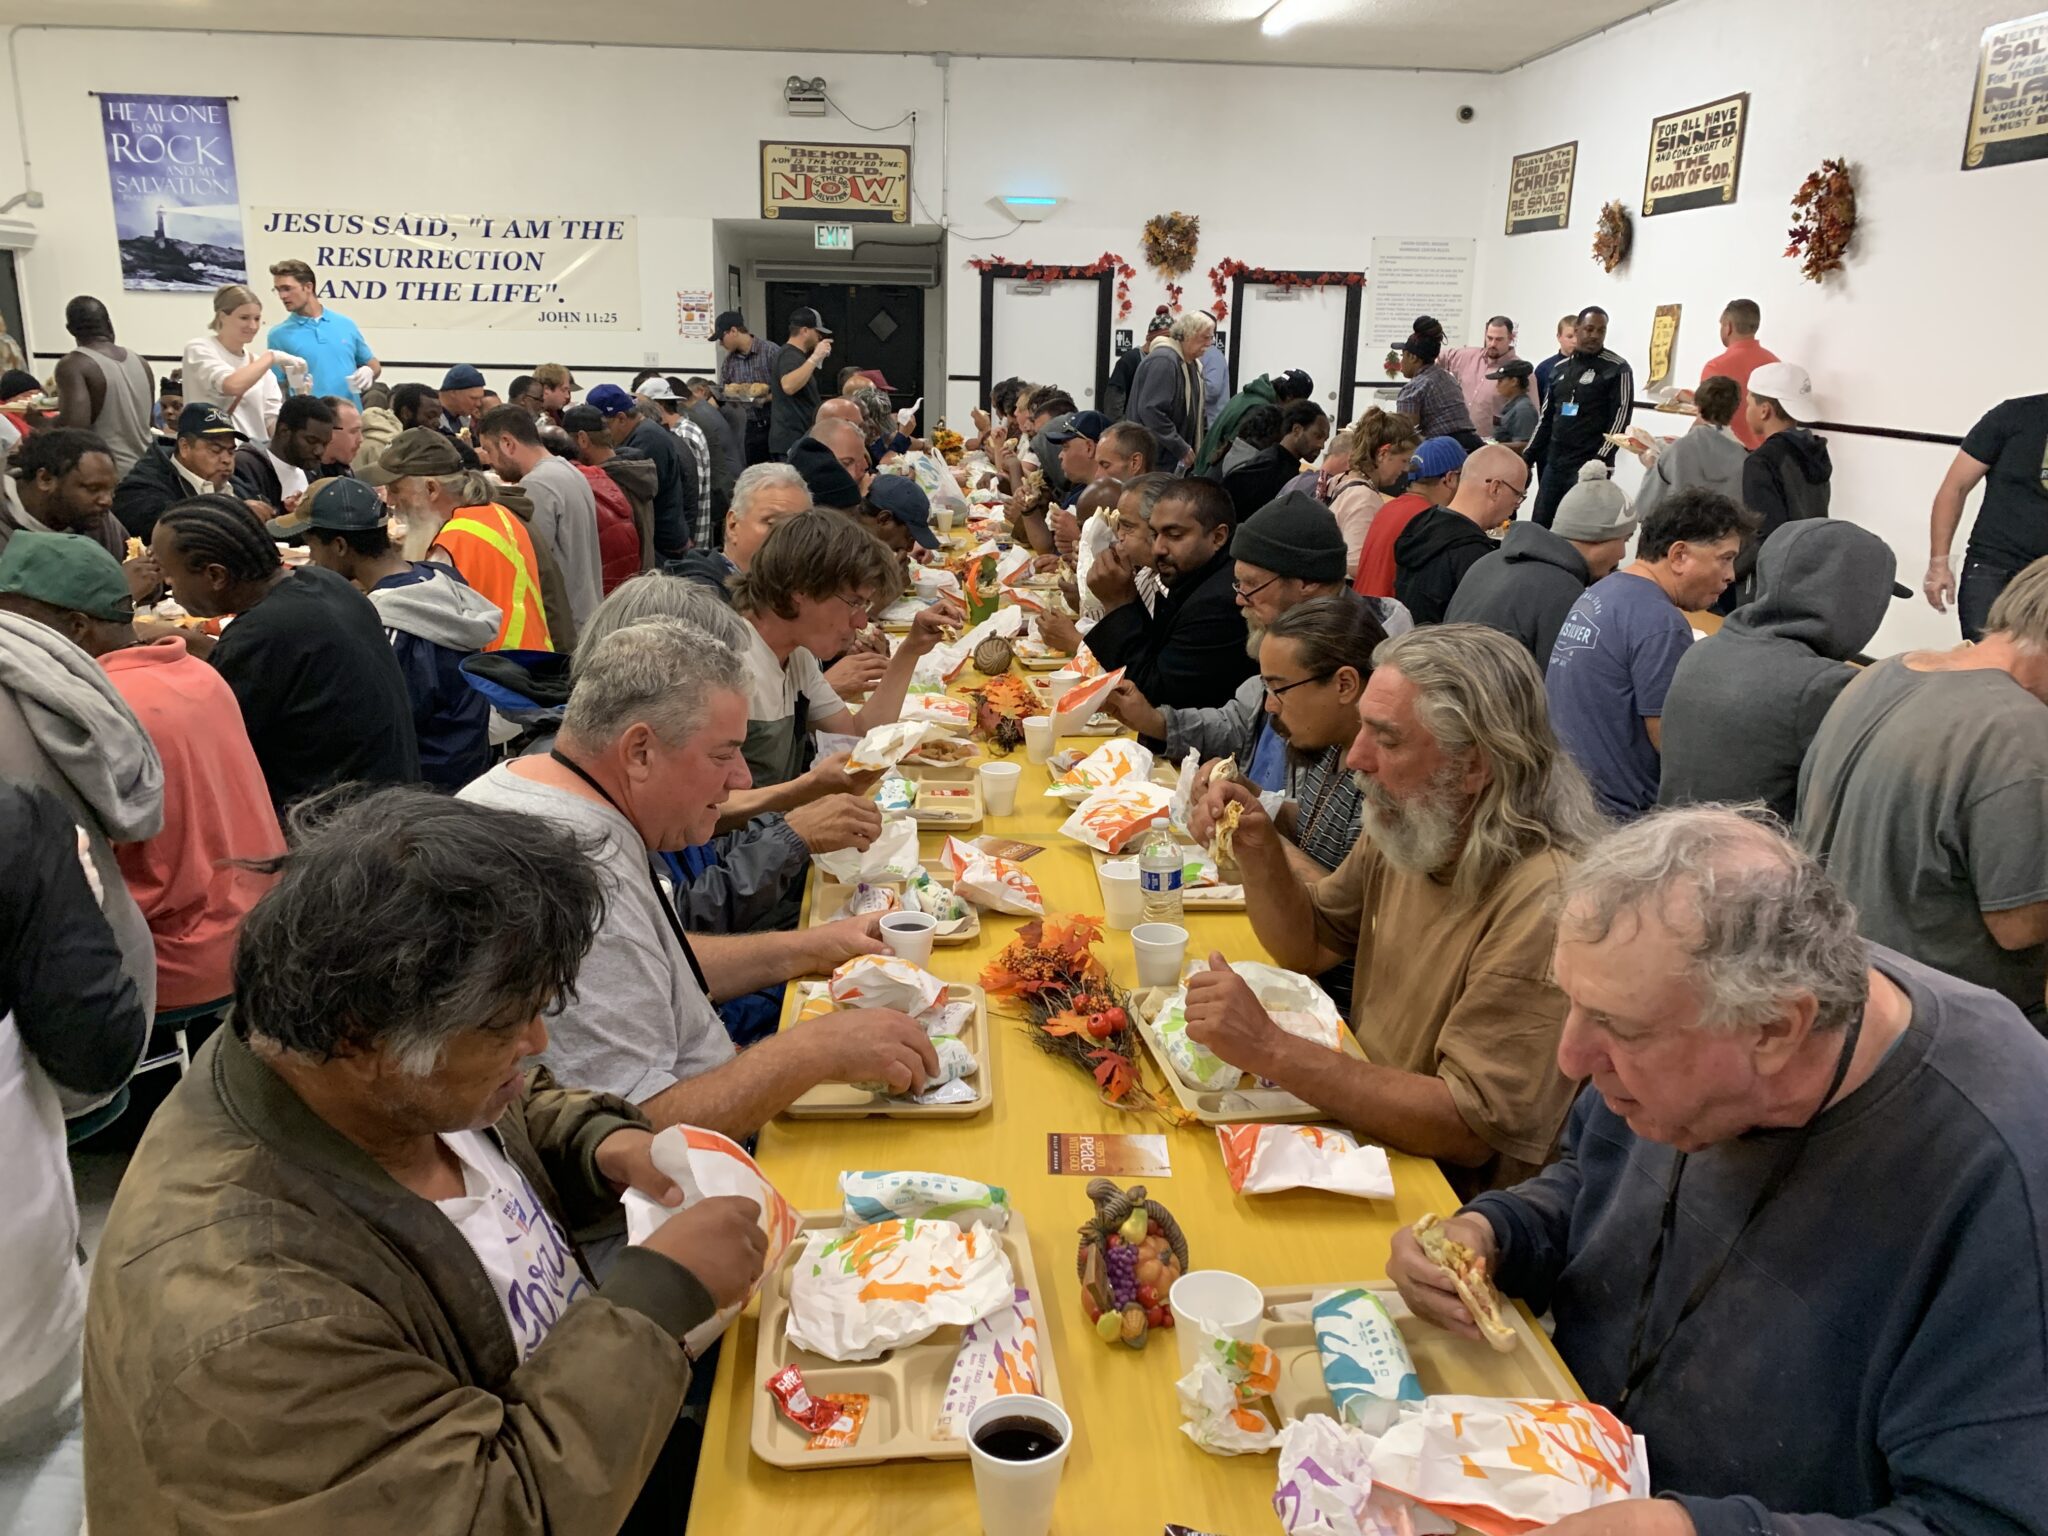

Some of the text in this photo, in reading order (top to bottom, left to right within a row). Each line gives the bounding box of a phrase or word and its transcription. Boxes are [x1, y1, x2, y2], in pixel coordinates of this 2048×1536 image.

[1992, 25, 2048, 46] NEITH
[1983, 74, 2048, 105] NA
[1987, 73, 2007, 86] FOR
[108, 102, 222, 124] HE ALONE
[1983, 97, 2027, 115] UNDER
[1990, 107, 2034, 123] AMONG
[131, 122, 164, 134] IS MY
[1659, 106, 1738, 138] FOR ALL HAVE
[1979, 114, 2048, 136] WE MUST B
[111, 133, 225, 165] ROCK
[1516, 157, 1544, 169] BELIEVE
[1556, 149, 1571, 159] THE
[1656, 136, 1734, 163] AND COME SHORT OF
[167, 165, 216, 177] AND MY
[1515, 157, 1571, 178] LORD JESUS
[1673, 153, 1711, 172] THE
[116, 175, 229, 195] SALVATION
[821, 175, 837, 183] THE
[1650, 171, 1687, 193] GLORY
[1688, 167, 1703, 185] OF
[1512, 198, 1525, 211] BE
[1514, 209, 1526, 217] AND
[1527, 208, 1541, 216] THY
[264, 212, 364, 235] JESUS
[372, 215, 457, 241] SAID,
[501, 219, 552, 239] AM
[561, 220, 624, 240] THE
[817, 226, 850, 246] EXIT
[315, 246, 545, 272] RESURRECTION
[317, 279, 387, 300] AND
[396, 281, 462, 302] THE
[538, 311, 617, 324] JOHN 11:25
[1068, 1136, 1080, 1171] WITH GOD
